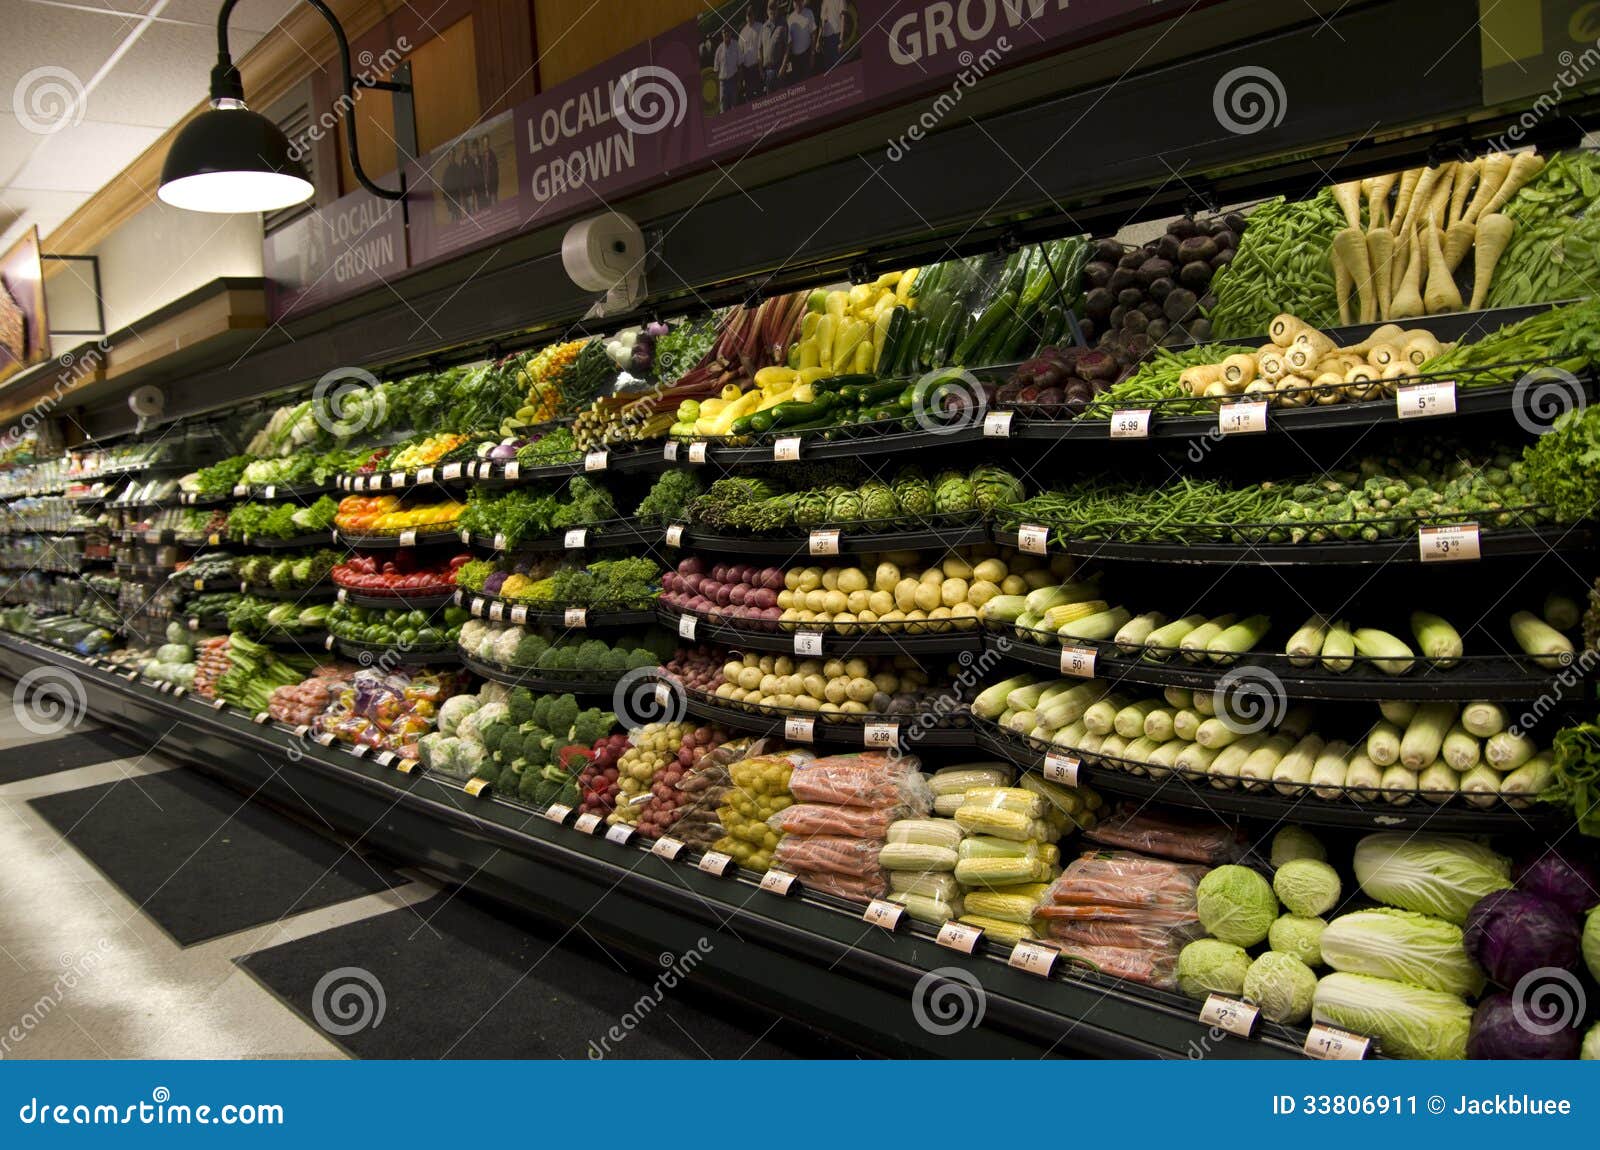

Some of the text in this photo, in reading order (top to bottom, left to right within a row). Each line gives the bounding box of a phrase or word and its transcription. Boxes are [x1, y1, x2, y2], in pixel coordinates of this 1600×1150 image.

[527, 68, 638, 154] LOCALLY
[532, 128, 635, 202] GROWN
[330, 196, 393, 245] LOCALLY
[335, 233, 394, 283] GROWN
